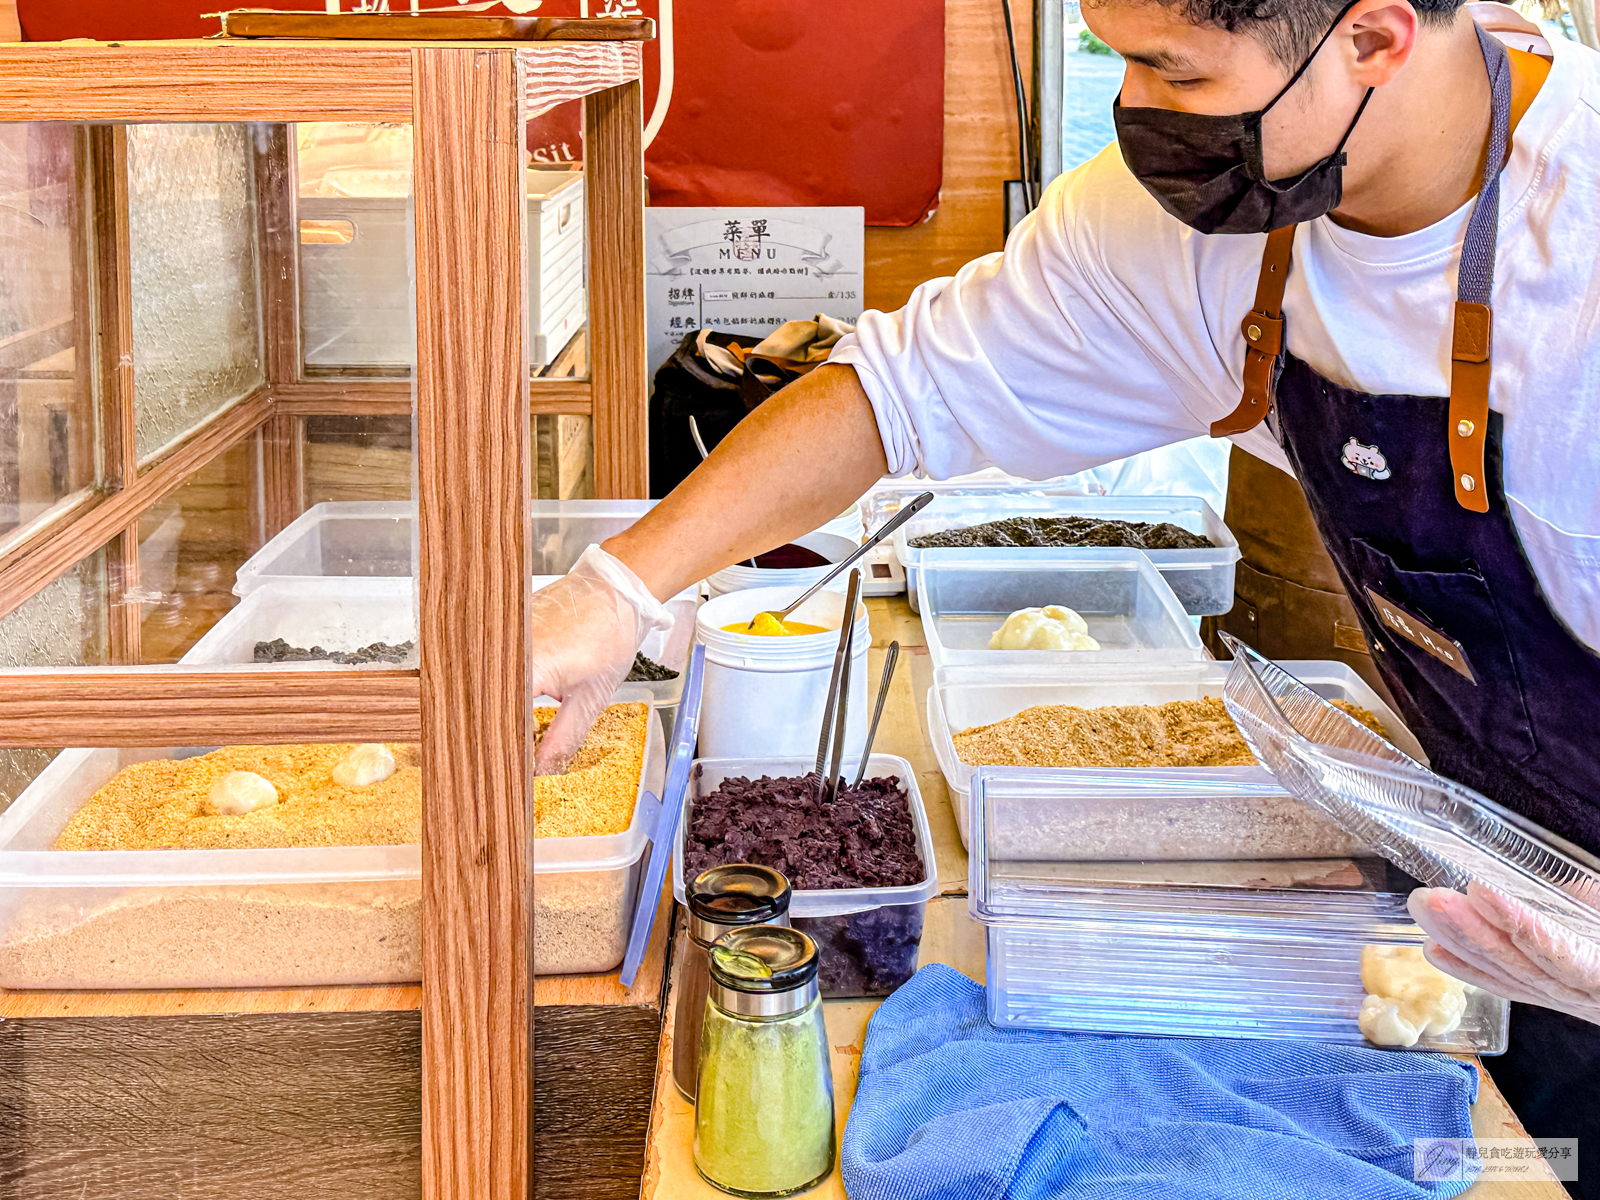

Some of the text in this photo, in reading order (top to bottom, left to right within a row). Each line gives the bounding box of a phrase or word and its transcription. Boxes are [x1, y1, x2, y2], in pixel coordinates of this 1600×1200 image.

[723, 219, 771, 243] 菜單
[719, 248, 777, 260] MENU
[668, 287, 695, 301] 招牌
[669, 316, 697, 329] 經典
